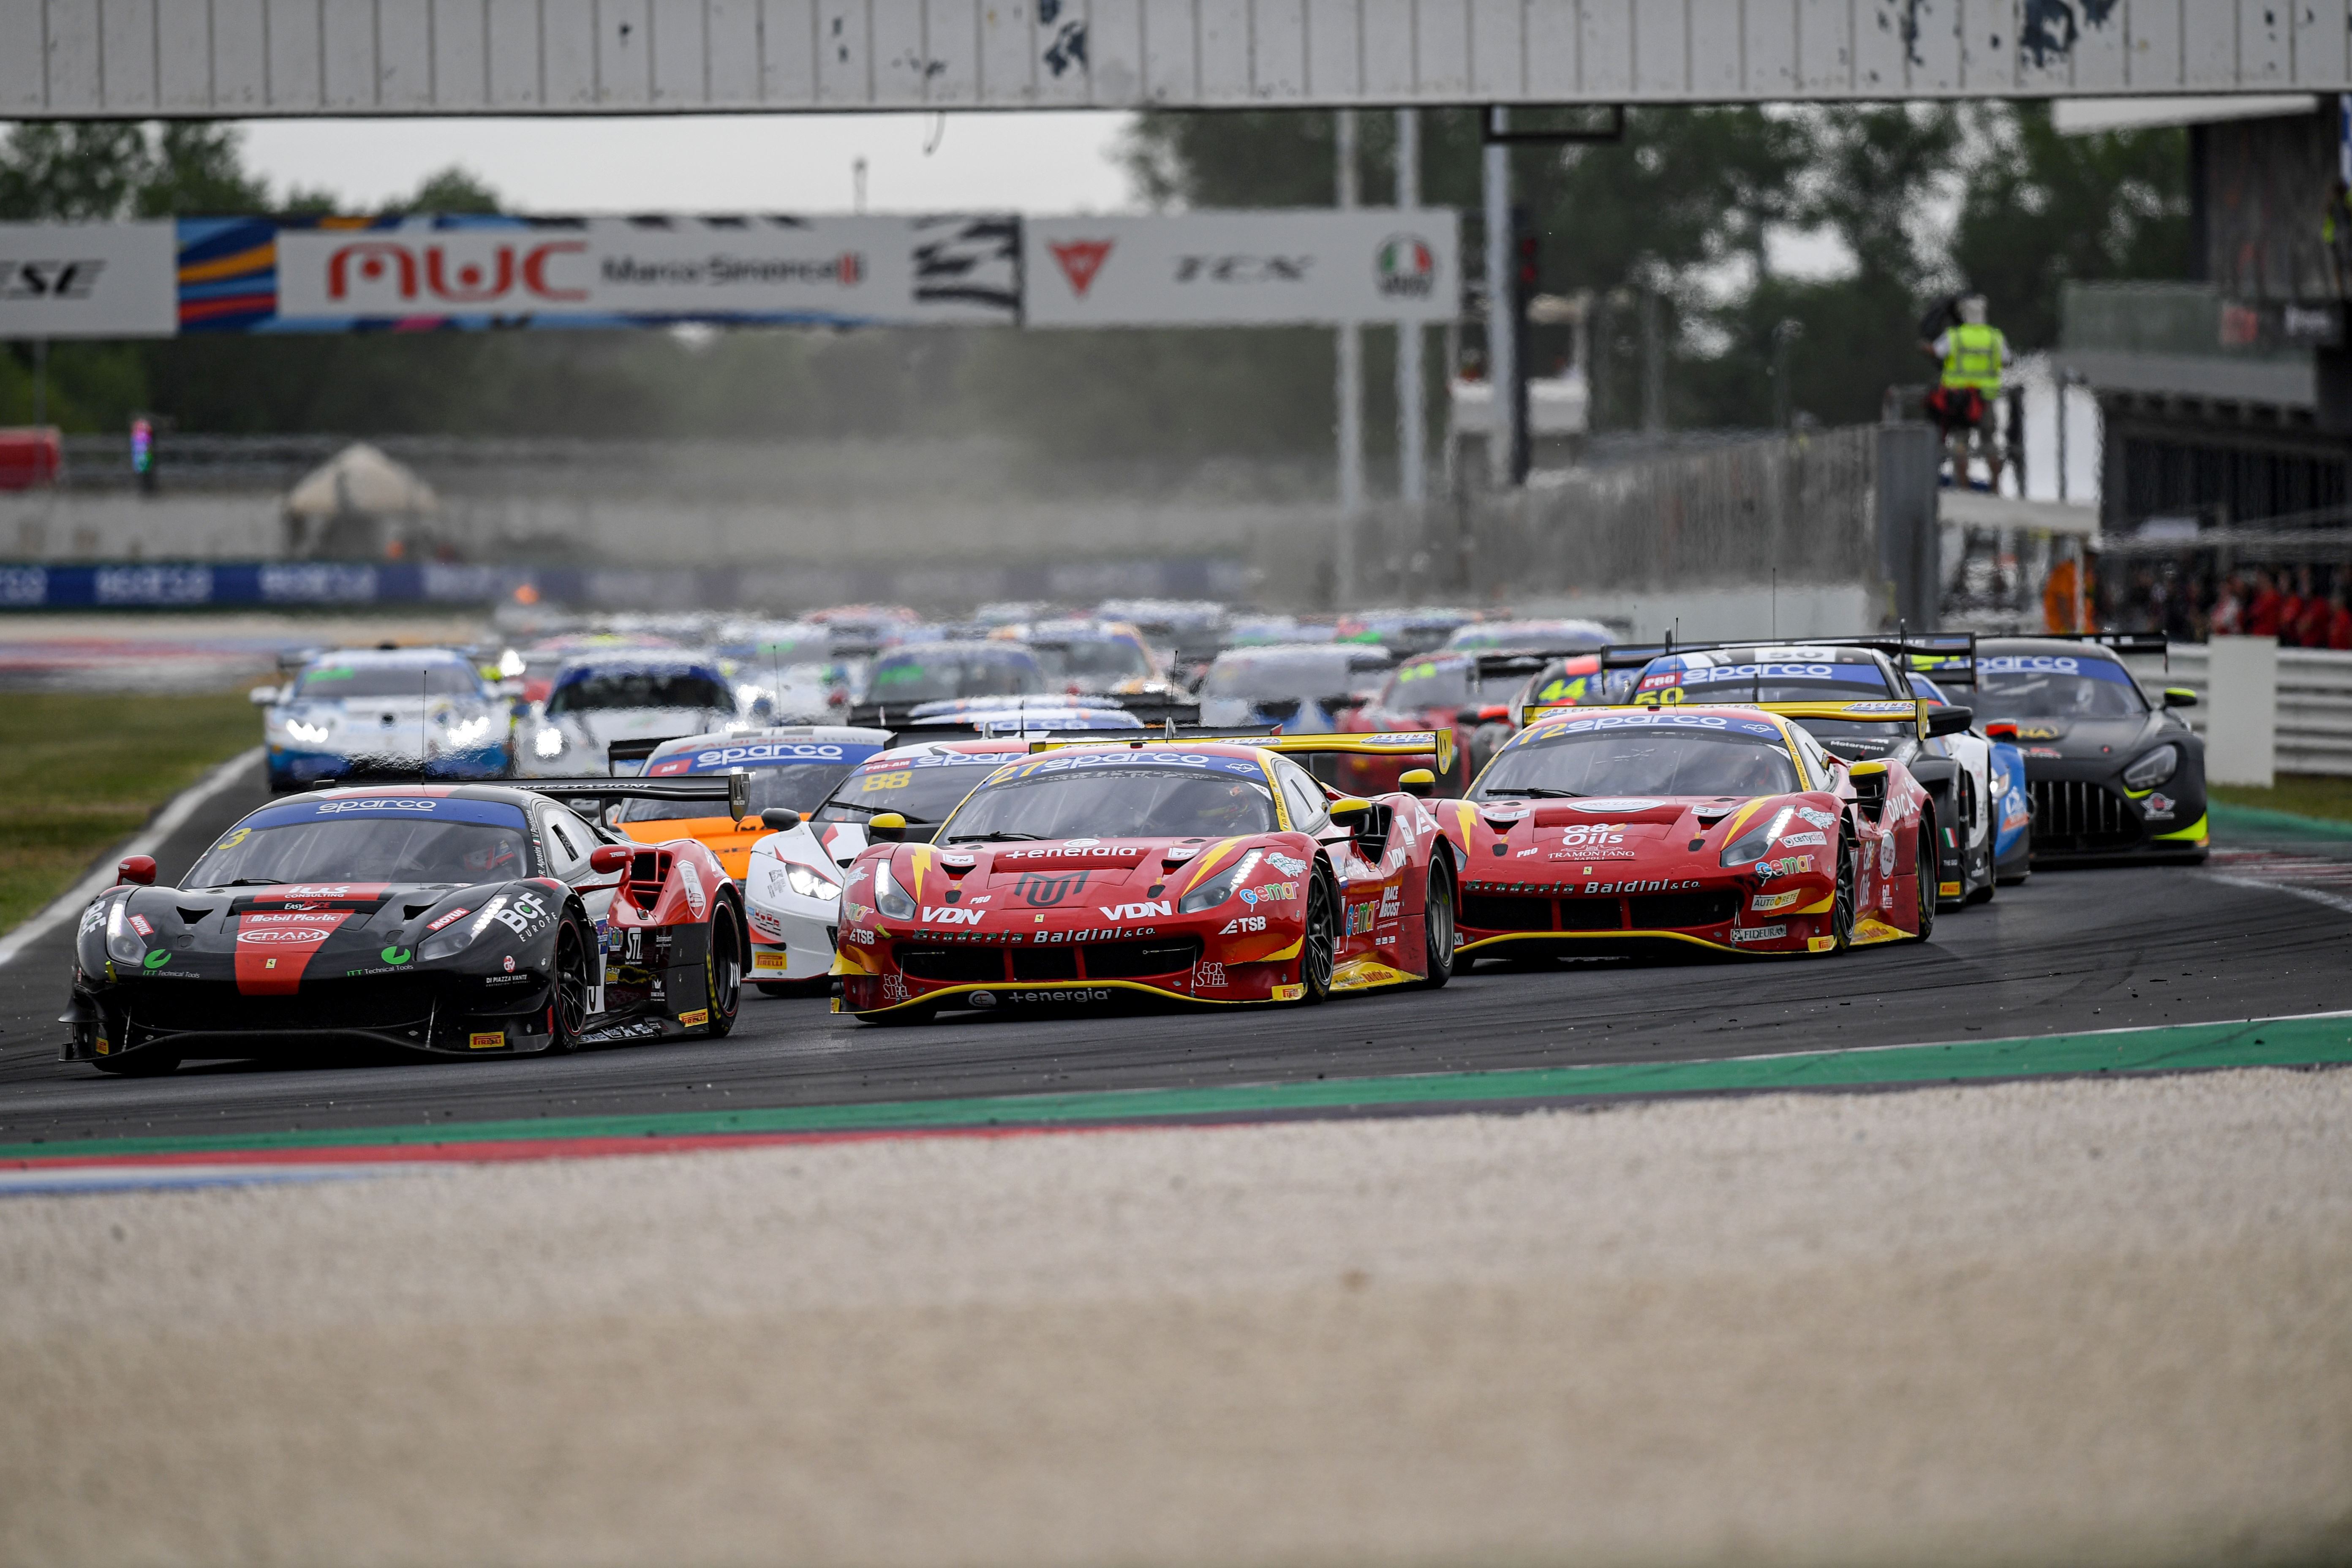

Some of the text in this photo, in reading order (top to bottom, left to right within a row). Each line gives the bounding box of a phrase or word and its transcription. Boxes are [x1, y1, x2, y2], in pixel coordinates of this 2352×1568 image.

[1644, 675, 1675, 687] PRO
[1682, 664, 1832, 684] sparco
[1566, 715, 1727, 734] sparco
[1519, 723, 1567, 746] 72
[1830, 740, 1885, 752] Motorsport
[697, 744, 844, 767] sparco
[915, 753, 1026, 768] spar
[1042, 752, 1209, 773] sparco
[866, 760, 910, 771] PRO-AM
[989, 760, 1047, 786] 27
[862, 771, 912, 792] 88
[316, 800, 437, 814] sparco
[1564, 823, 1609, 834] Q8
[218, 828, 252, 850] 3
[1562, 832, 1624, 845] Oils
[533, 846, 545, 868] Agostini
[1387, 846, 1407, 869] VDN
[1516, 847, 1538, 858] PRO
[1548, 850, 1635, 859] TRAMONTANO
[1754, 854, 1815, 885] Gemar
[1385, 885, 1399, 901] RACE
[1470, 879, 1573, 894] Scuderia
[1584, 879, 1668, 894] Baldini
[969, 894, 992, 904] PRO
[1239, 882, 1300, 911] Gemar
[921, 906, 987, 926] VDN
[1098, 900, 1172, 920] VDN
[1383, 901, 1400, 917] BOOST
[130, 915, 151, 936] MOTUL
[251, 914, 292, 922] Mobil
[433, 908, 467, 929] MOTUL
[1346, 900, 1380, 944] Gemar
[519, 912, 558, 942] EUROPE
[917, 926, 1156, 944] Scuderia Baldini & Co.
[1744, 926, 1786, 939] FIDEURAM
[757, 955, 783, 967] PIRELLI
[1202, 962, 1223, 974] FOR
[364, 966, 395, 975] Technical
[883, 974, 904, 987] FOR
[1195, 972, 1228, 987] STEEL
[882, 983, 912, 999] STEEL
[1008, 986, 1108, 1003] +energia
[473, 1034, 501, 1046] PIRELLI
